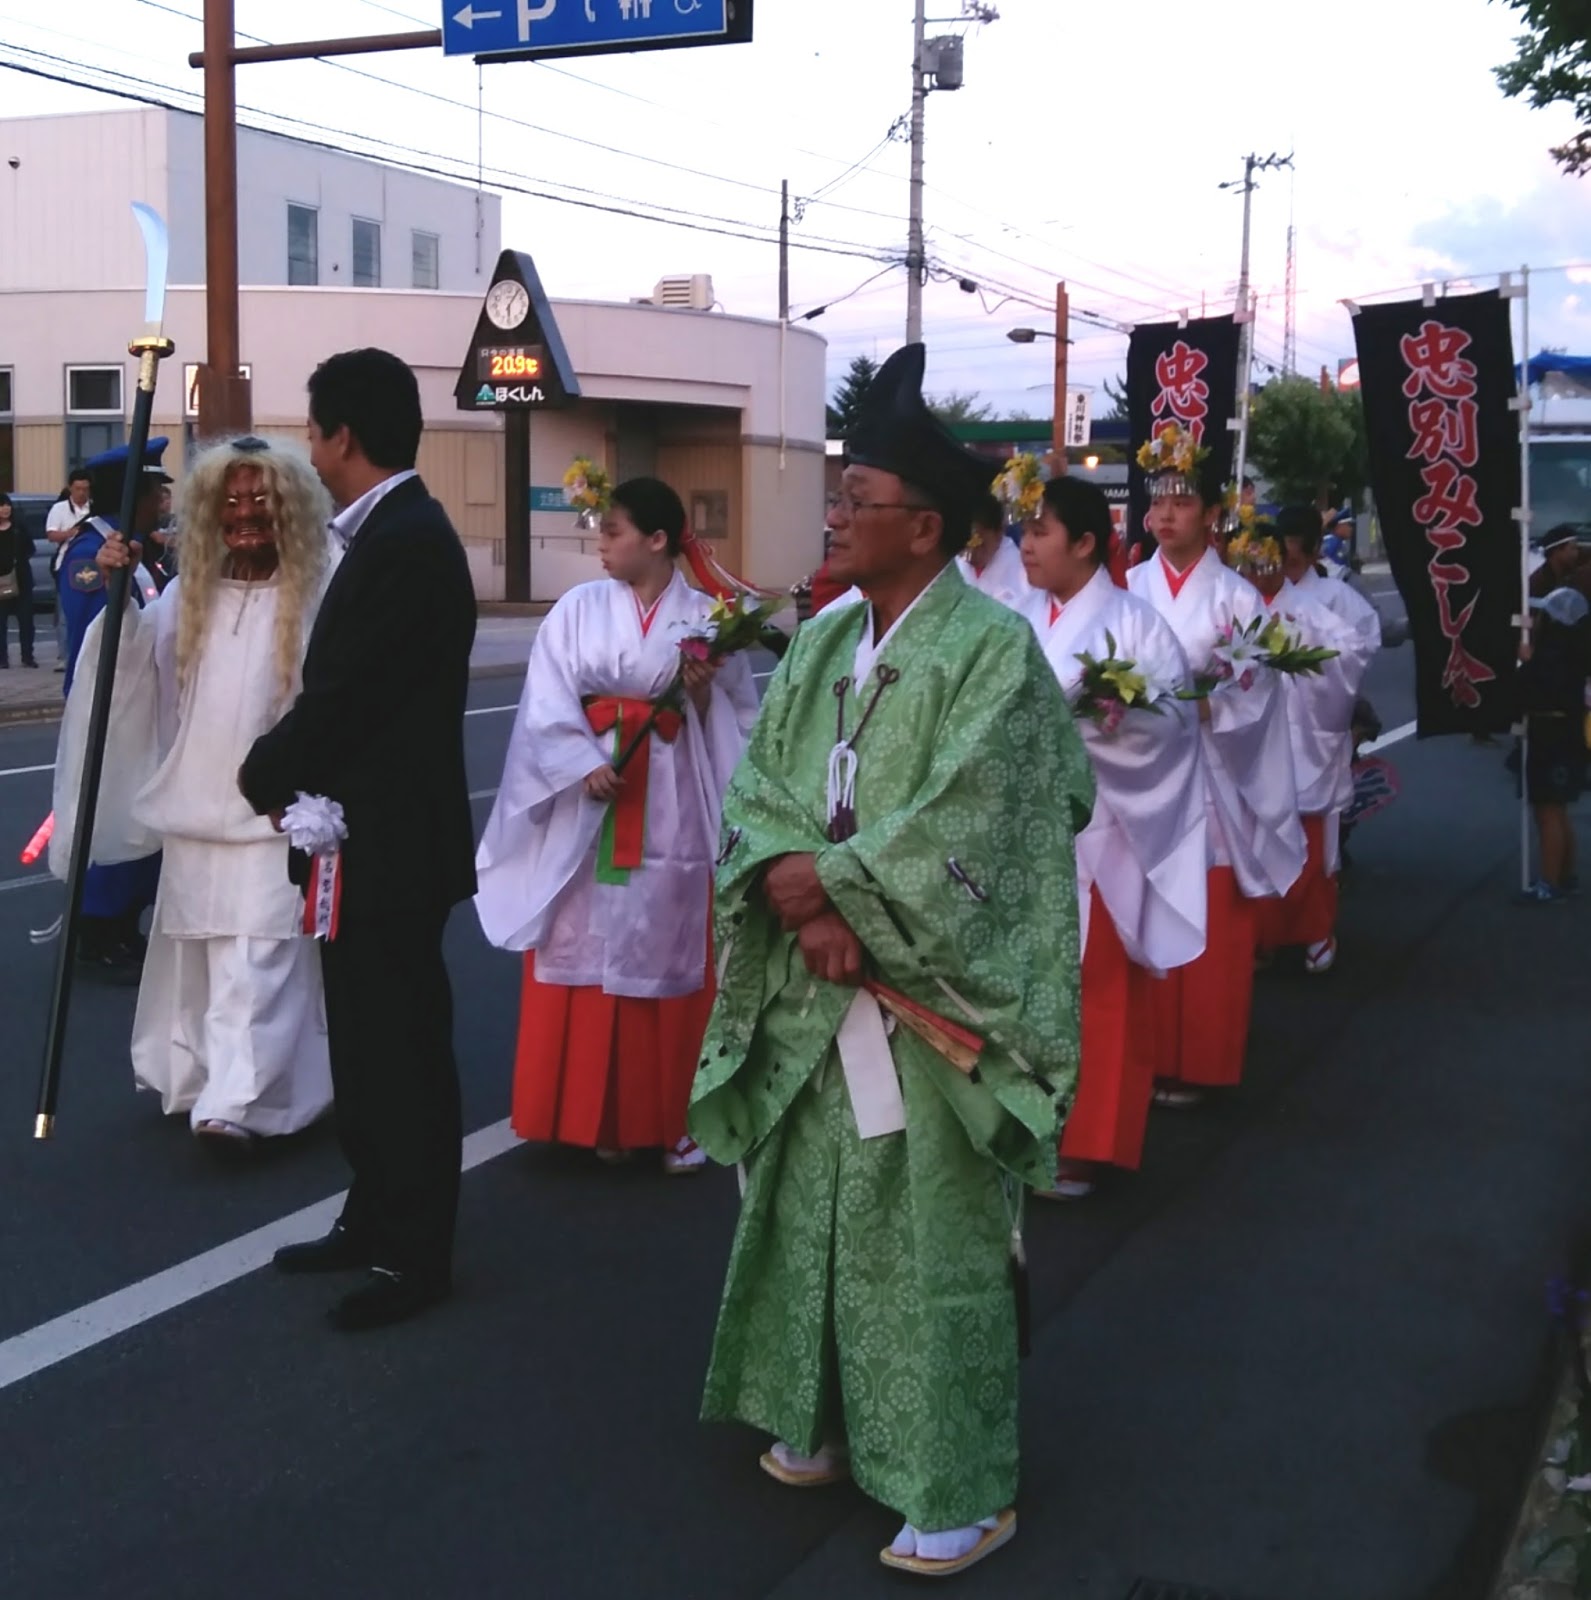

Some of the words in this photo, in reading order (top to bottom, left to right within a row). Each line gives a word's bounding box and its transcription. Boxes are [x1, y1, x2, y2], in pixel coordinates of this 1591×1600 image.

[517, 0, 557, 42] P
[495, 386, 545, 401] ほくしん
[1400, 319, 1496, 709] 忠別みこし会
